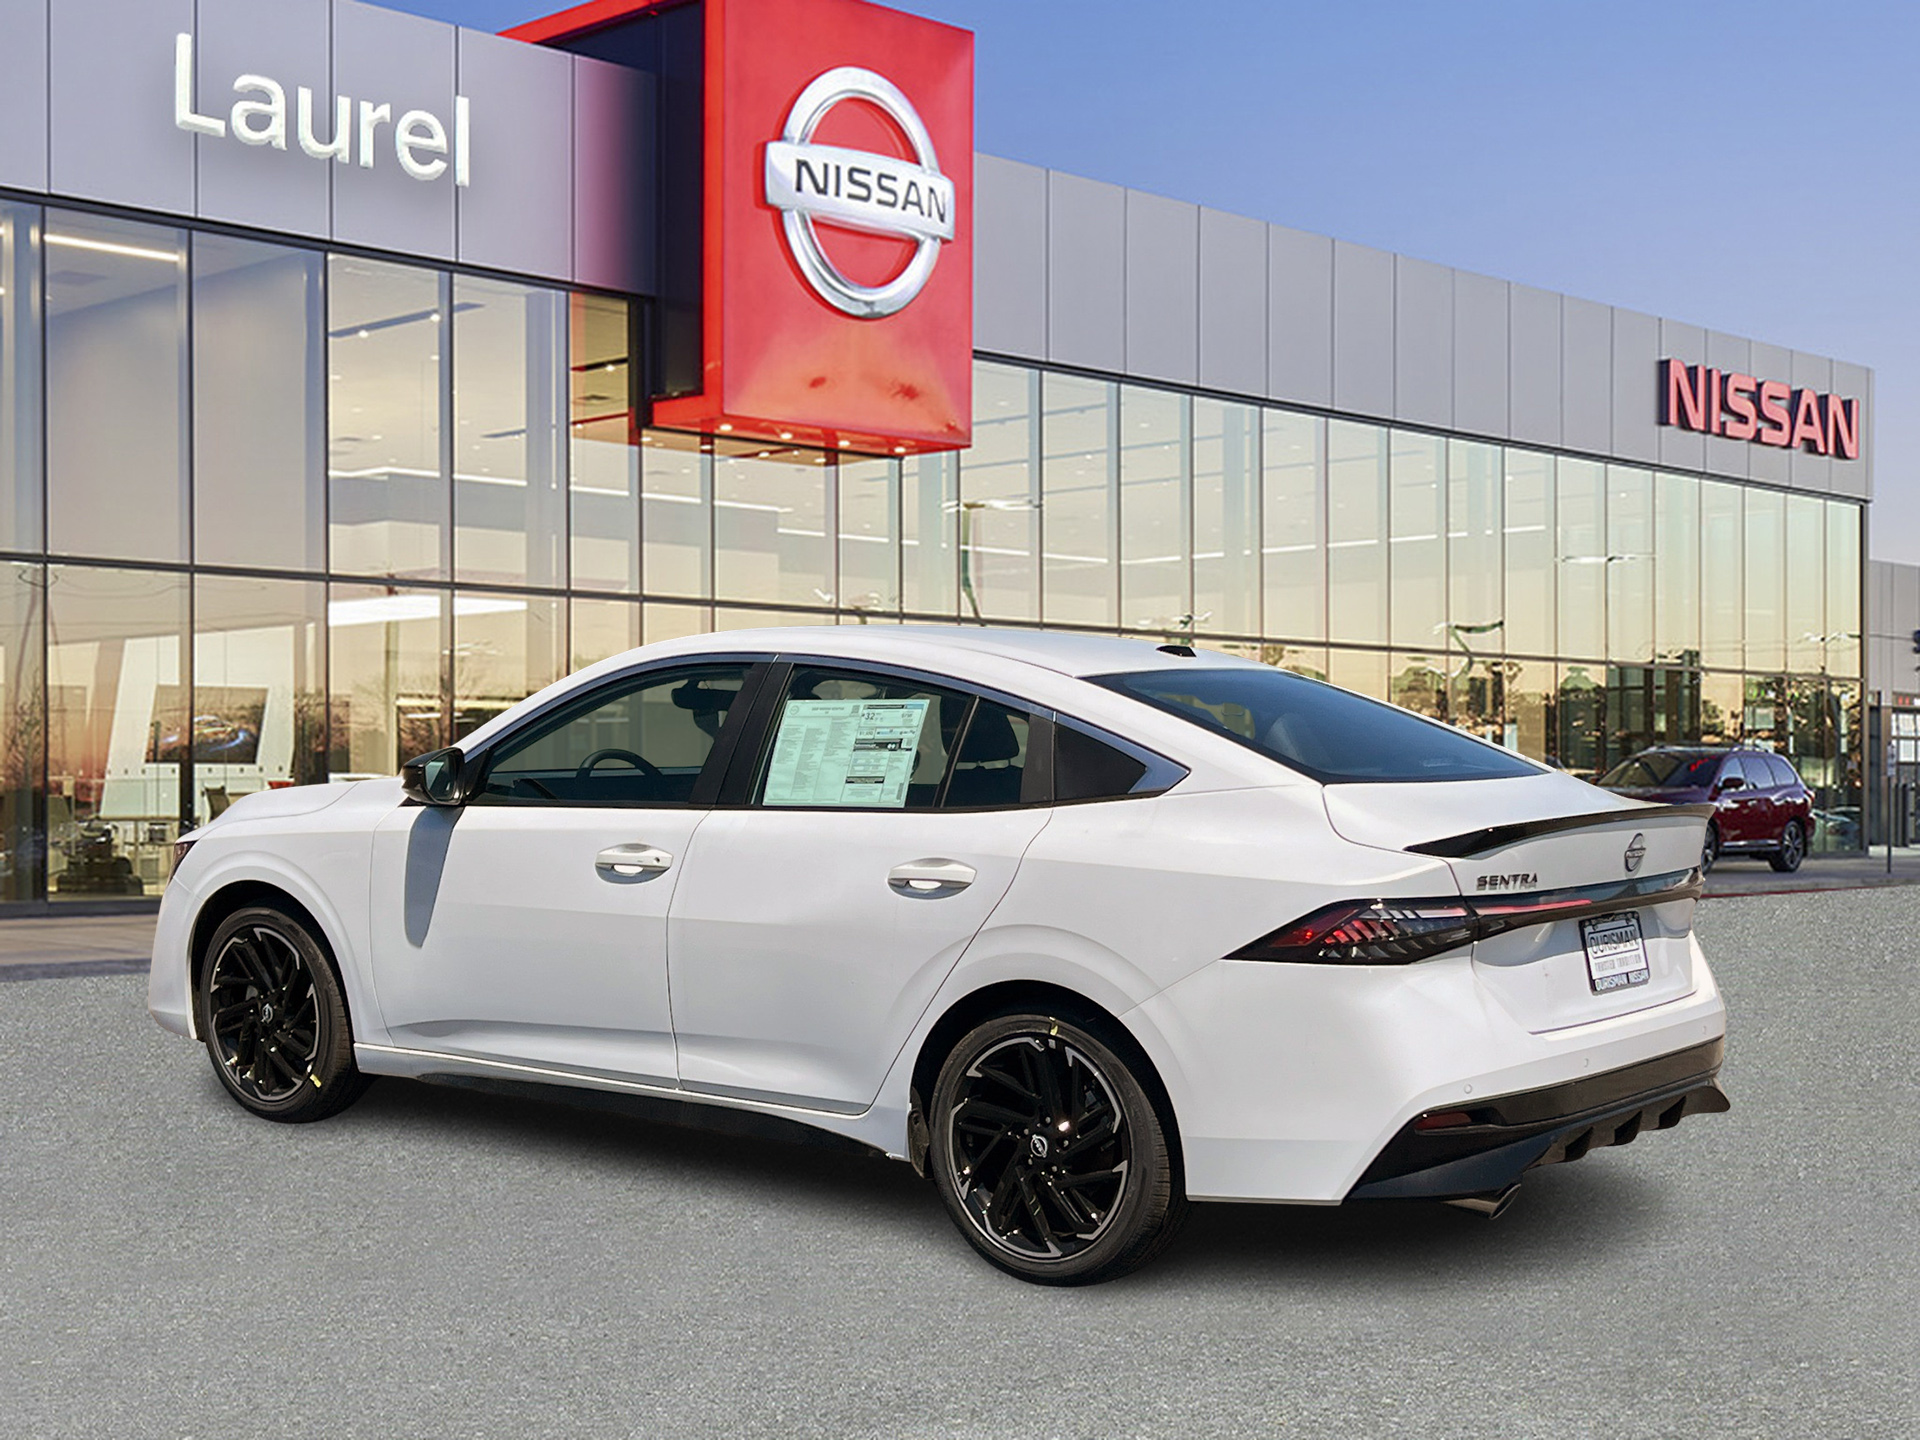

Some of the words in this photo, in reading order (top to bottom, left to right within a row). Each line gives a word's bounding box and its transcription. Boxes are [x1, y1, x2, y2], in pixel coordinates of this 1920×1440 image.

[176, 33, 469, 187] Laurel
[795, 159, 946, 223] NISSAN
[1659, 358, 1859, 460] NISSAN
[1477, 873, 1538, 887] SENTRA
